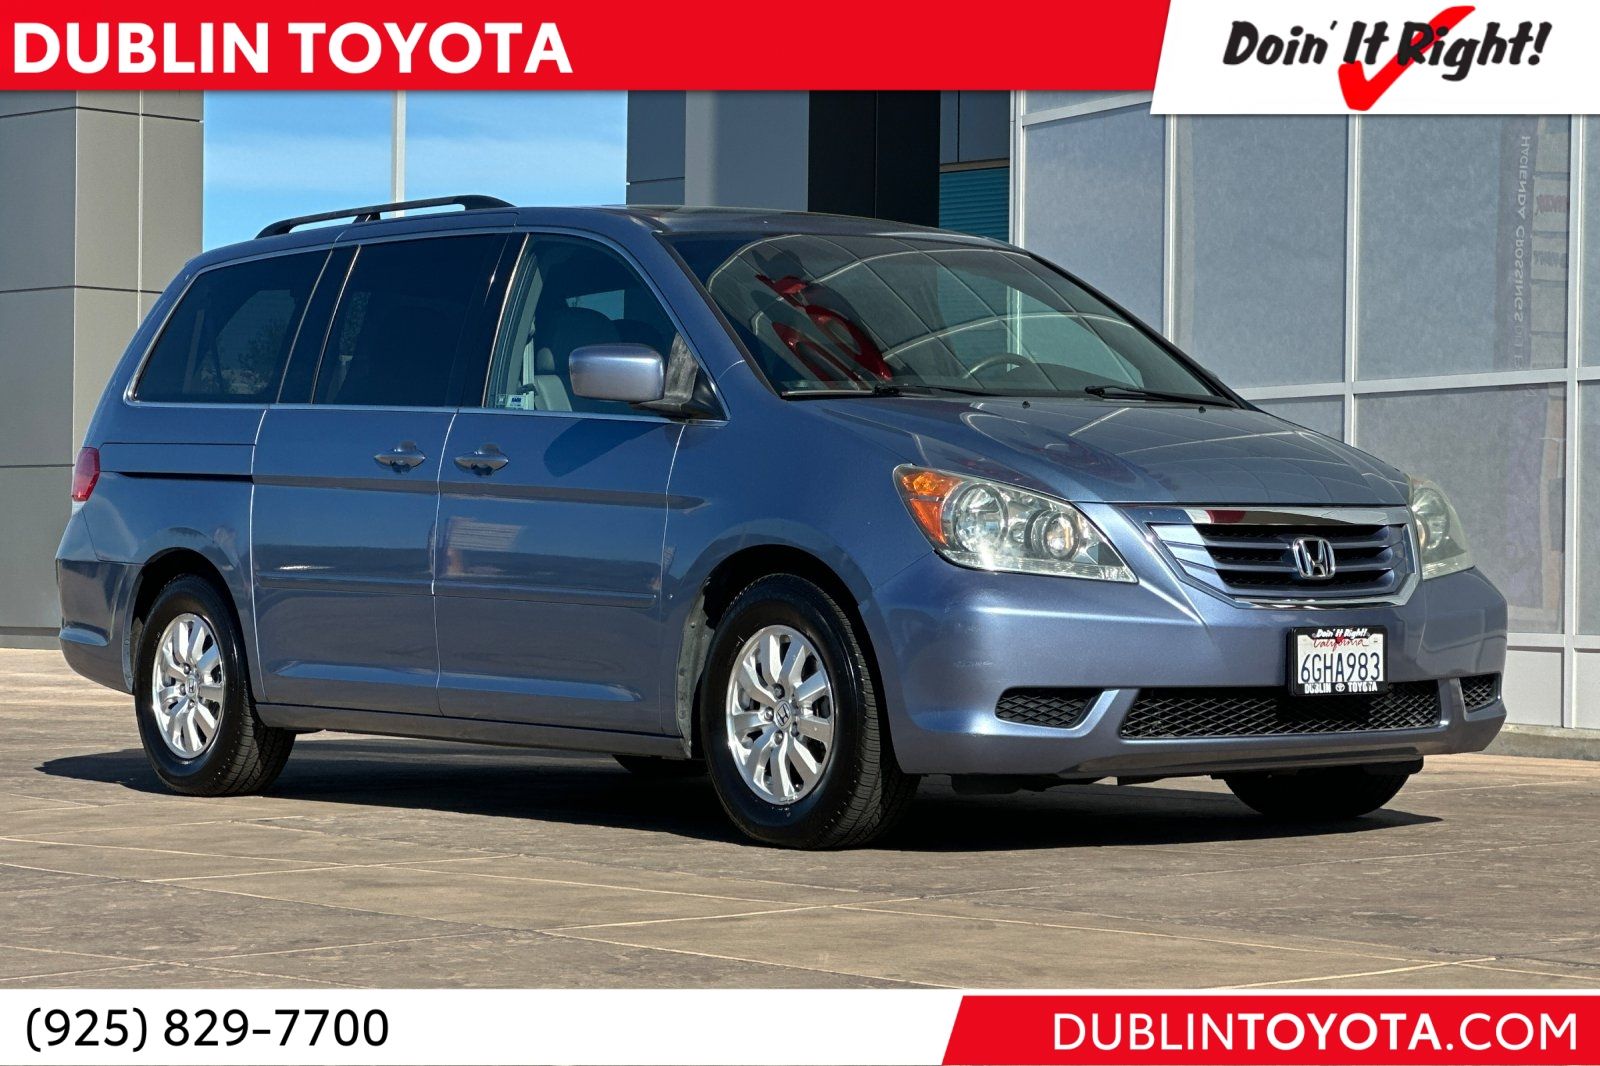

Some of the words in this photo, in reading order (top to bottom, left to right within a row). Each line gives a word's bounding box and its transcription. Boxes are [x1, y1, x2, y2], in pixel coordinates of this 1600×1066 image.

[1301, 652, 1380, 683] 6GHA983
[1304, 683, 1332, 694] DUBLIN
[1347, 681, 1378, 693] TOYOTA
